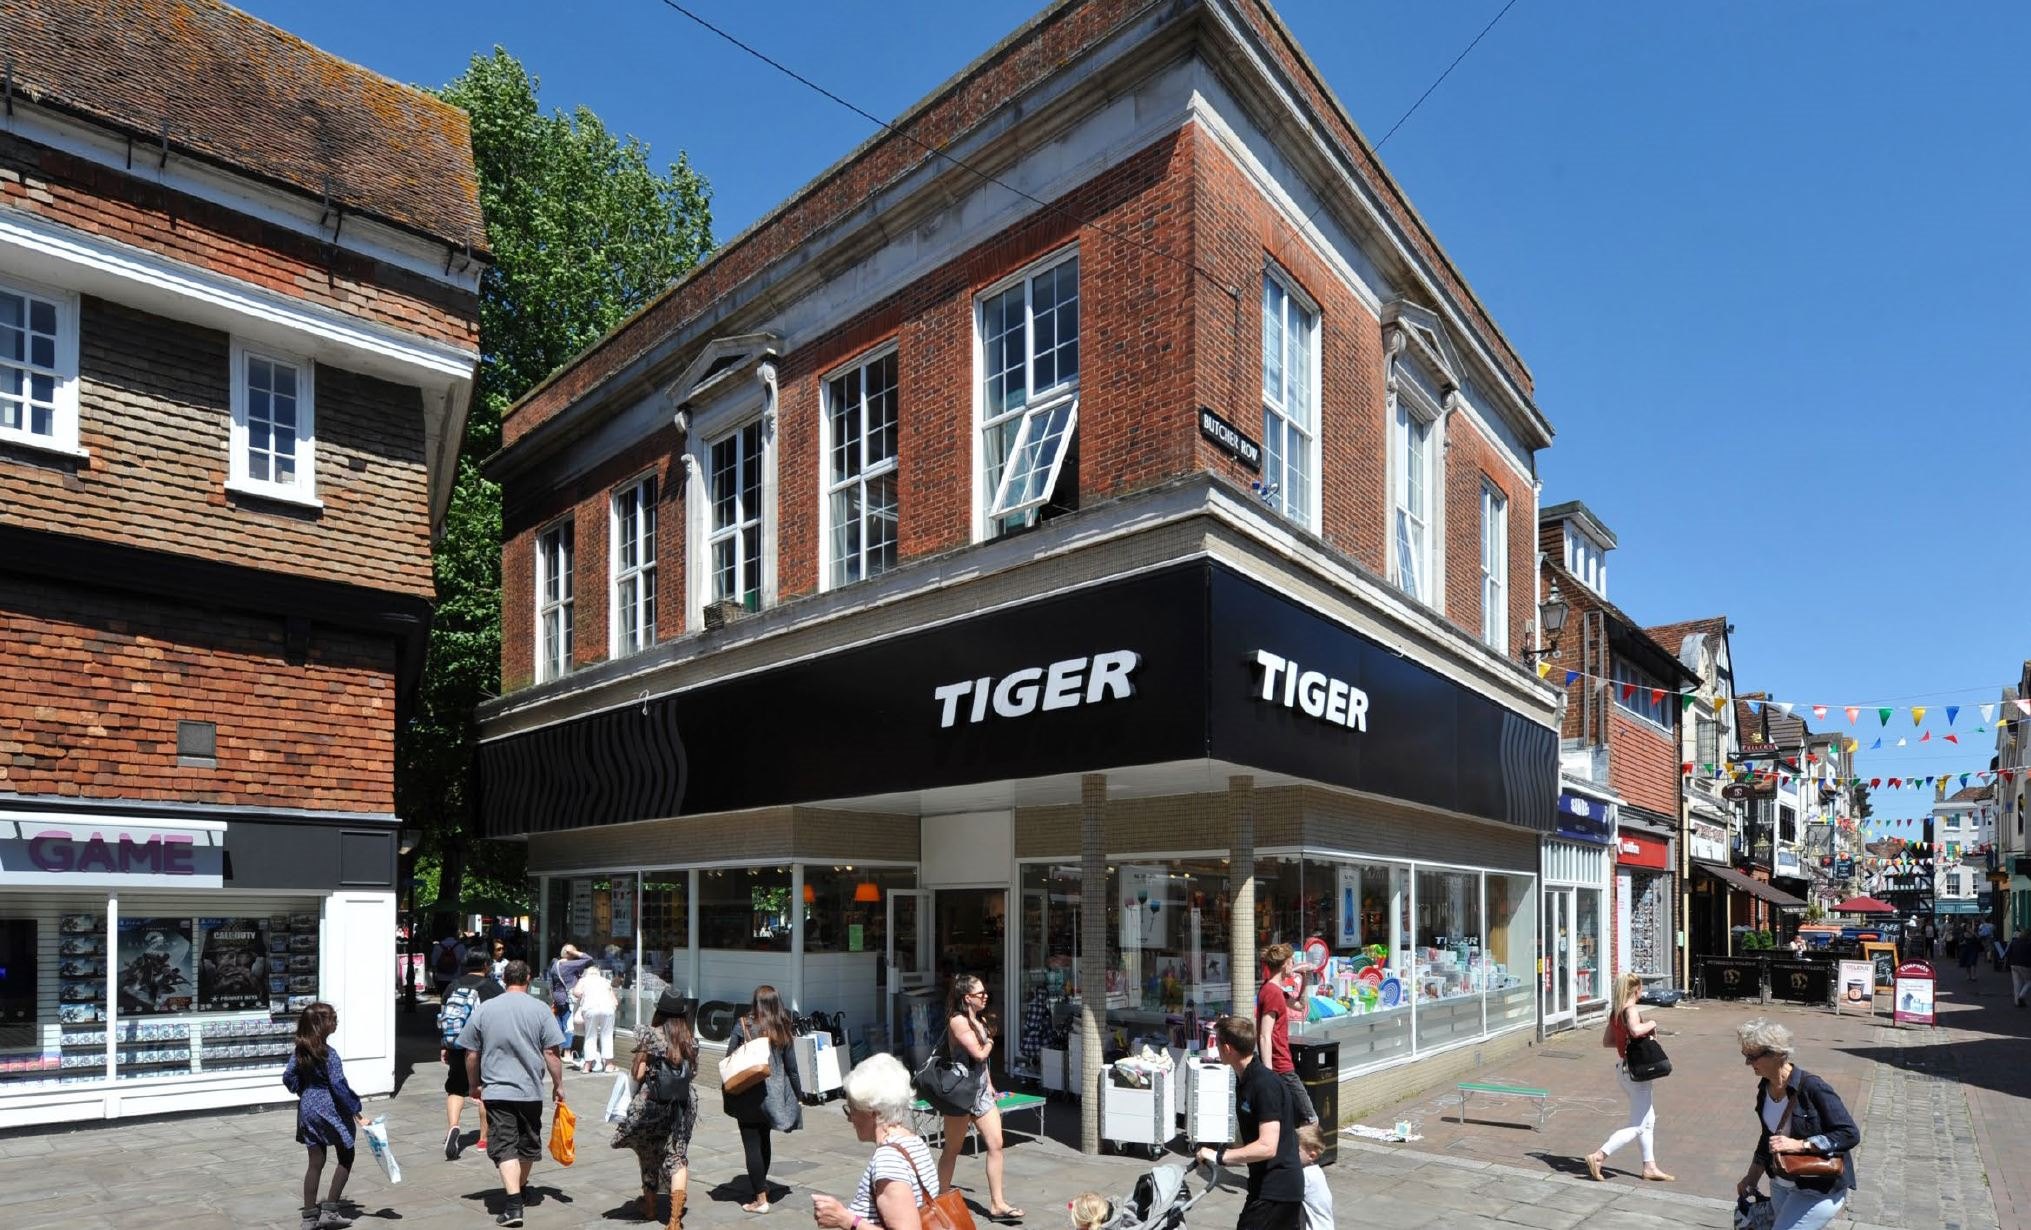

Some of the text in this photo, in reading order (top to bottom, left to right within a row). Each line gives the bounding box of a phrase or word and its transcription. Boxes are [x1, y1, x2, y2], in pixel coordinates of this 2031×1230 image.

[1203, 413, 1258, 461] BUTCHER ROW
[934, 649, 1139, 728] TIGER
[1256, 648, 1369, 733] TIGER
[28, 829, 194, 875] GAME
[213, 931, 232, 940] CALL
[235, 931, 256, 940] DUTY
[1434, 936, 1479, 945] TIER
[1899, 963, 1930, 973] TIMPSON
